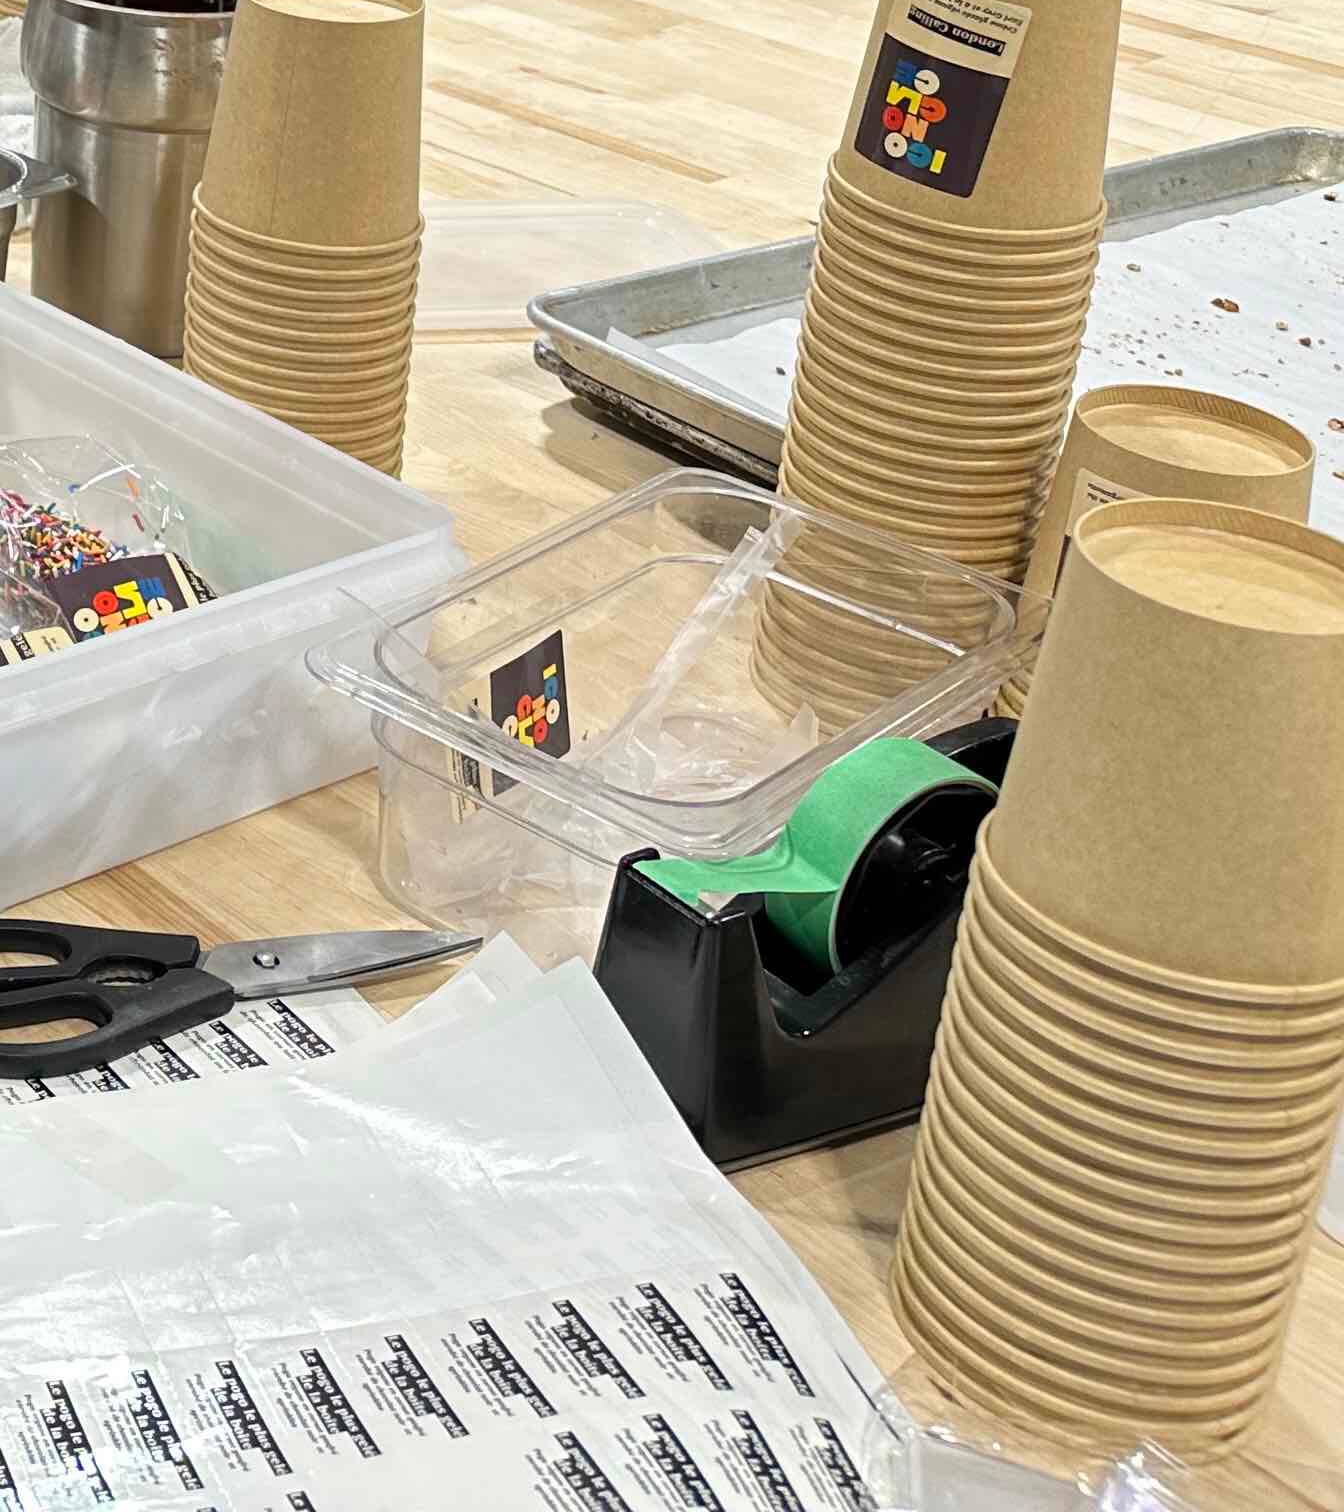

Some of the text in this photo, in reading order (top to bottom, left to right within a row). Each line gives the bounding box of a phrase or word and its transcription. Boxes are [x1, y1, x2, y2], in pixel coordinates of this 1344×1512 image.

[950, 27, 1004, 53] London
[300, 1349, 320, 1363] Le
[216, 1361, 235, 1376] Le
[392, 1351, 423, 1377] pogo
[294, 1374, 317, 1390] de
[306, 1365, 336, 1393] pogo
[210, 1387, 231, 1402] de
[222, 1378, 250, 1407] pogo
[305, 1391, 325, 1403] la
[328, 1394, 347, 1406] le
[219, 1405, 239, 1416] la
[242, 1409, 260, 1420] le
[332, 1407, 363, 1432] plus
[247, 1423, 275, 1448] plus
